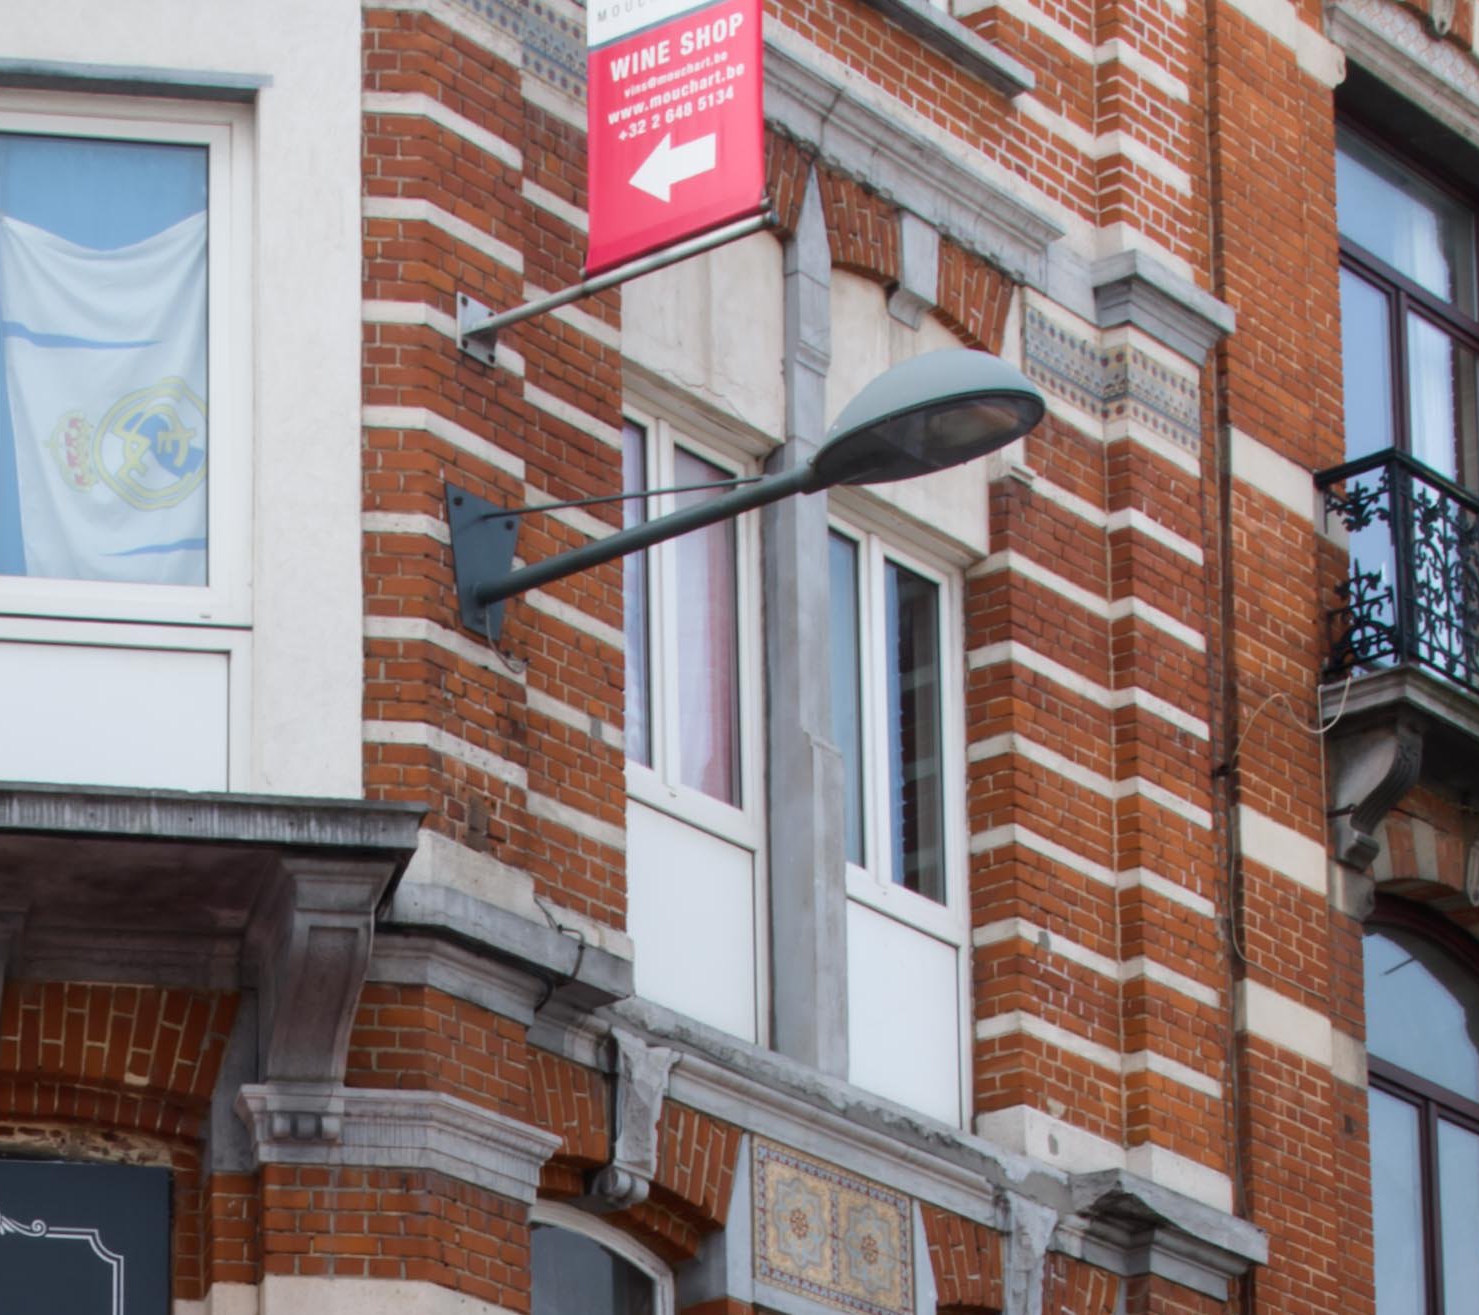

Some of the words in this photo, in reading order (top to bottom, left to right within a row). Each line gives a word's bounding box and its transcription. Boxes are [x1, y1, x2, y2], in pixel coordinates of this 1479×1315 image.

[609, 39, 671, 83] WINE
[680, 11, 744, 56] SHOP
[623, 50, 729, 99] vins@mouchart.be
[607, 62, 746, 125] www.mouchart.be
[618, 119, 647, 142] +32
[651, 113, 661, 130] 2
[665, 100, 693, 127] 648
[697, 85, 735, 112] 5134
